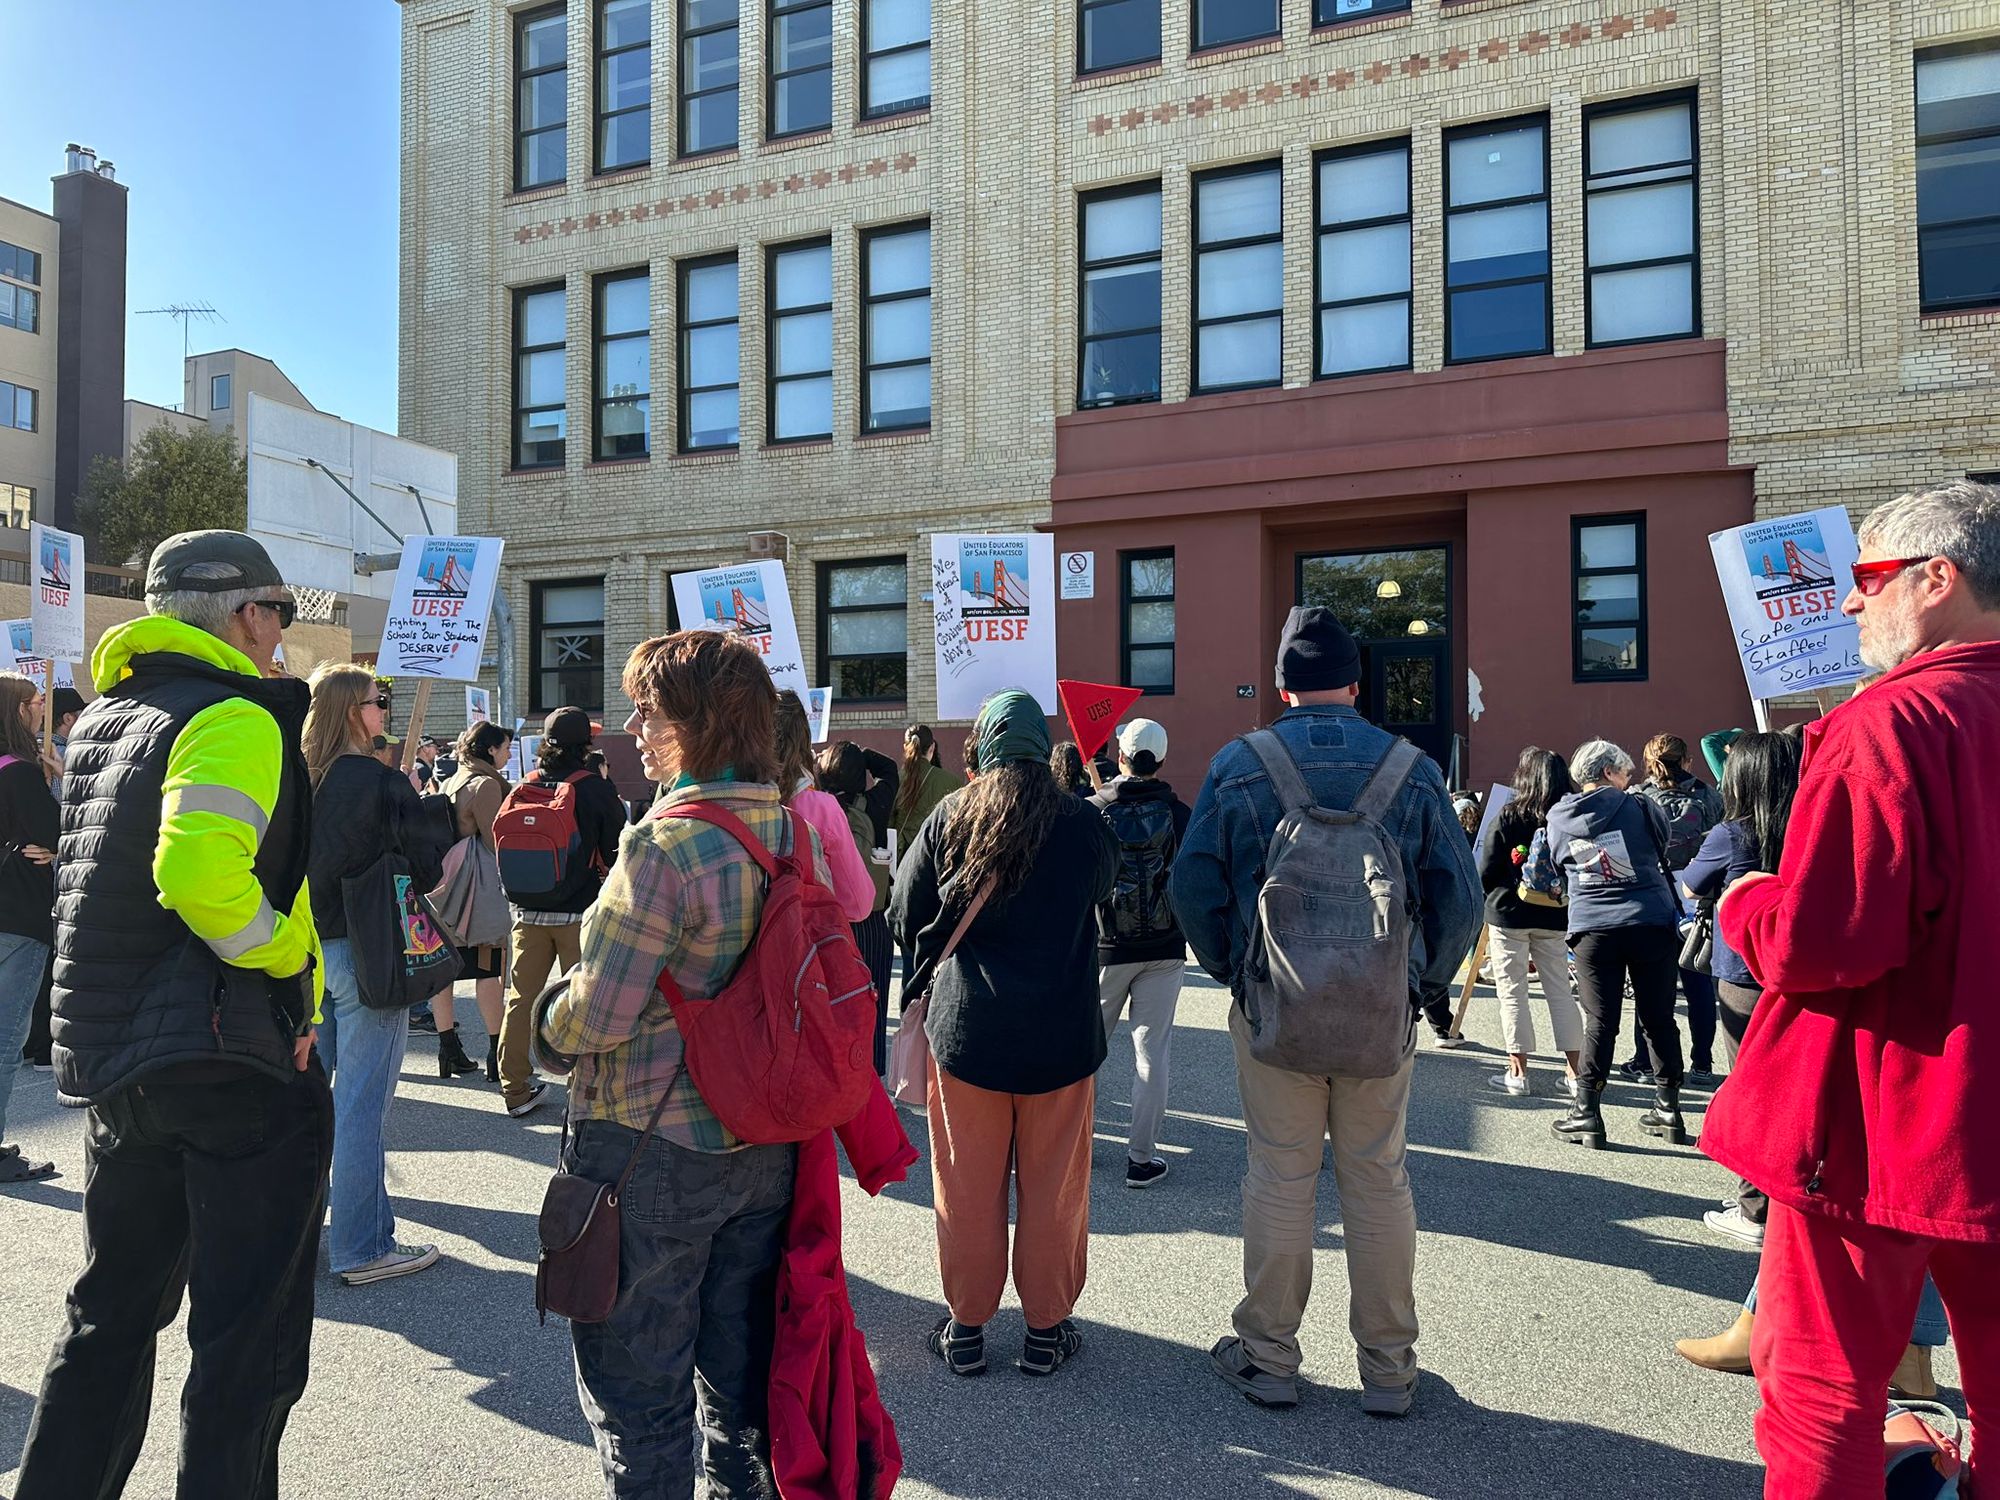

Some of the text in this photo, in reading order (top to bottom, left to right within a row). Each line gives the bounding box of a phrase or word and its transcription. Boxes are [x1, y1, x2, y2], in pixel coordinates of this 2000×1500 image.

[1744, 520, 1813, 538] UNITED EDUCATORS
[1758, 535, 1774, 543] SAN
[1775, 527, 1813, 538] FRANCISCO
[988, 541, 1024, 549] EDUCATORS
[701, 570, 757, 584] UNITED EDUCATORS
[726, 577, 757, 586] FRANCISCO
[41, 586, 70, 607] UESF
[1762, 589, 1836, 621] UESF
[412, 599, 464, 617] UESF
[389, 617, 481, 631] Fighting For The
[966, 619, 1029, 642] UESF
[1741, 611, 1828, 648] Safe and
[387, 631, 479, 643] Schools Our Students
[399, 642, 460, 658] DESERVE!
[1750, 635, 1828, 671] Staffed
[18, 661, 47, 676] UES
[1780, 650, 1860, 682] Schools
[1086, 698, 1113, 721] UESF
